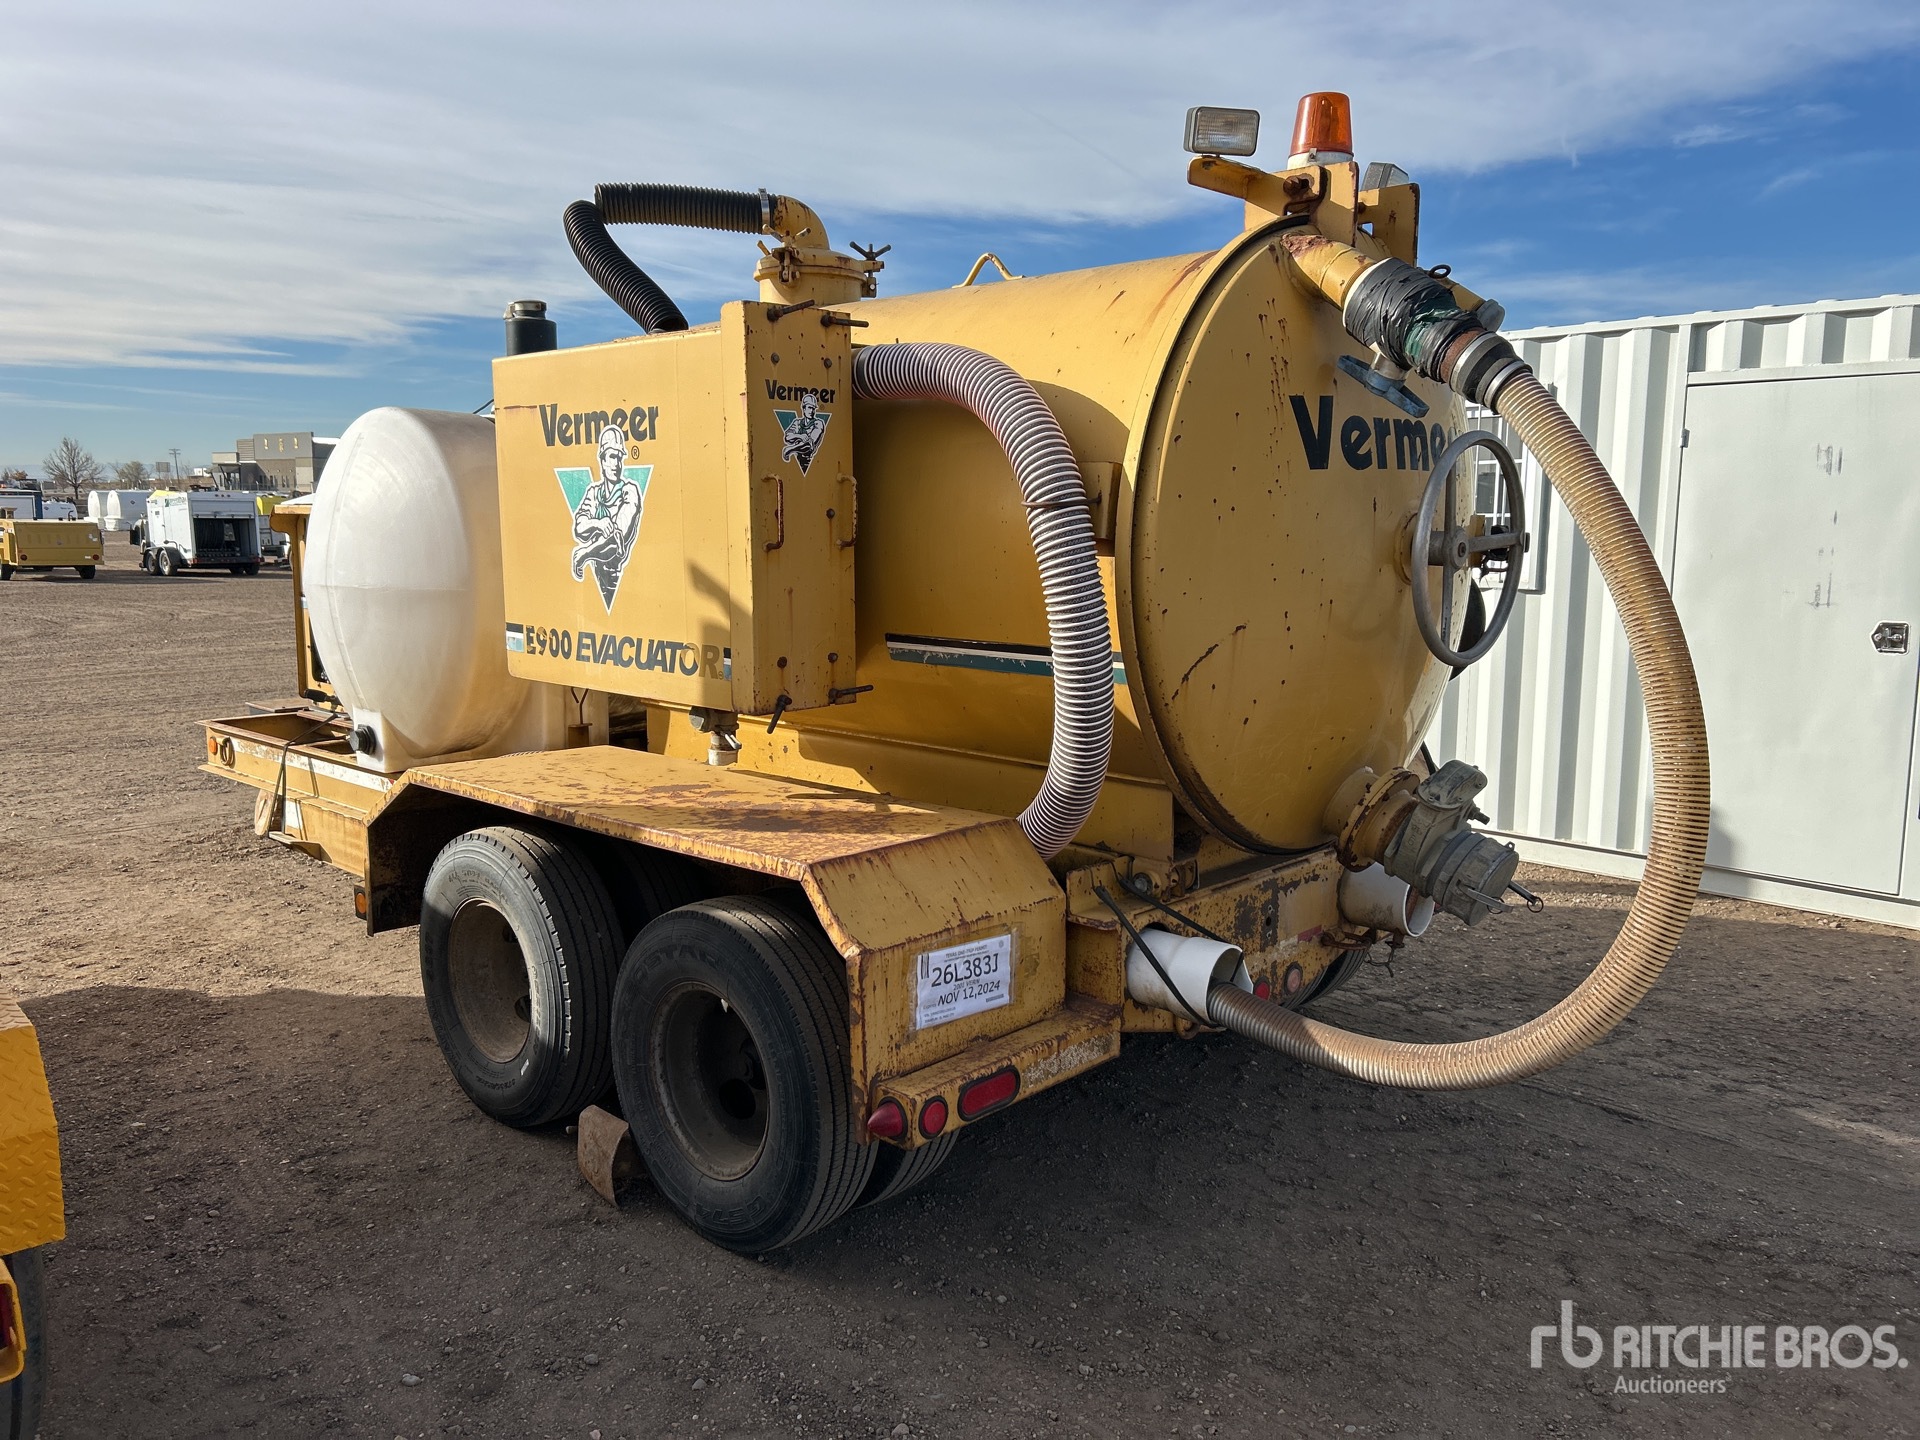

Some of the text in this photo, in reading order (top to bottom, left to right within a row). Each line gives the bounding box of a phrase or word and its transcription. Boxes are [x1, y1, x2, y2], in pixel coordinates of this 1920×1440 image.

[1289, 395, 1459, 471] Verme
[525, 625, 720, 679] E900 EVACUATOR
[931, 953, 999, 988] 26L383J
[937, 990, 960, 1007] NOV
